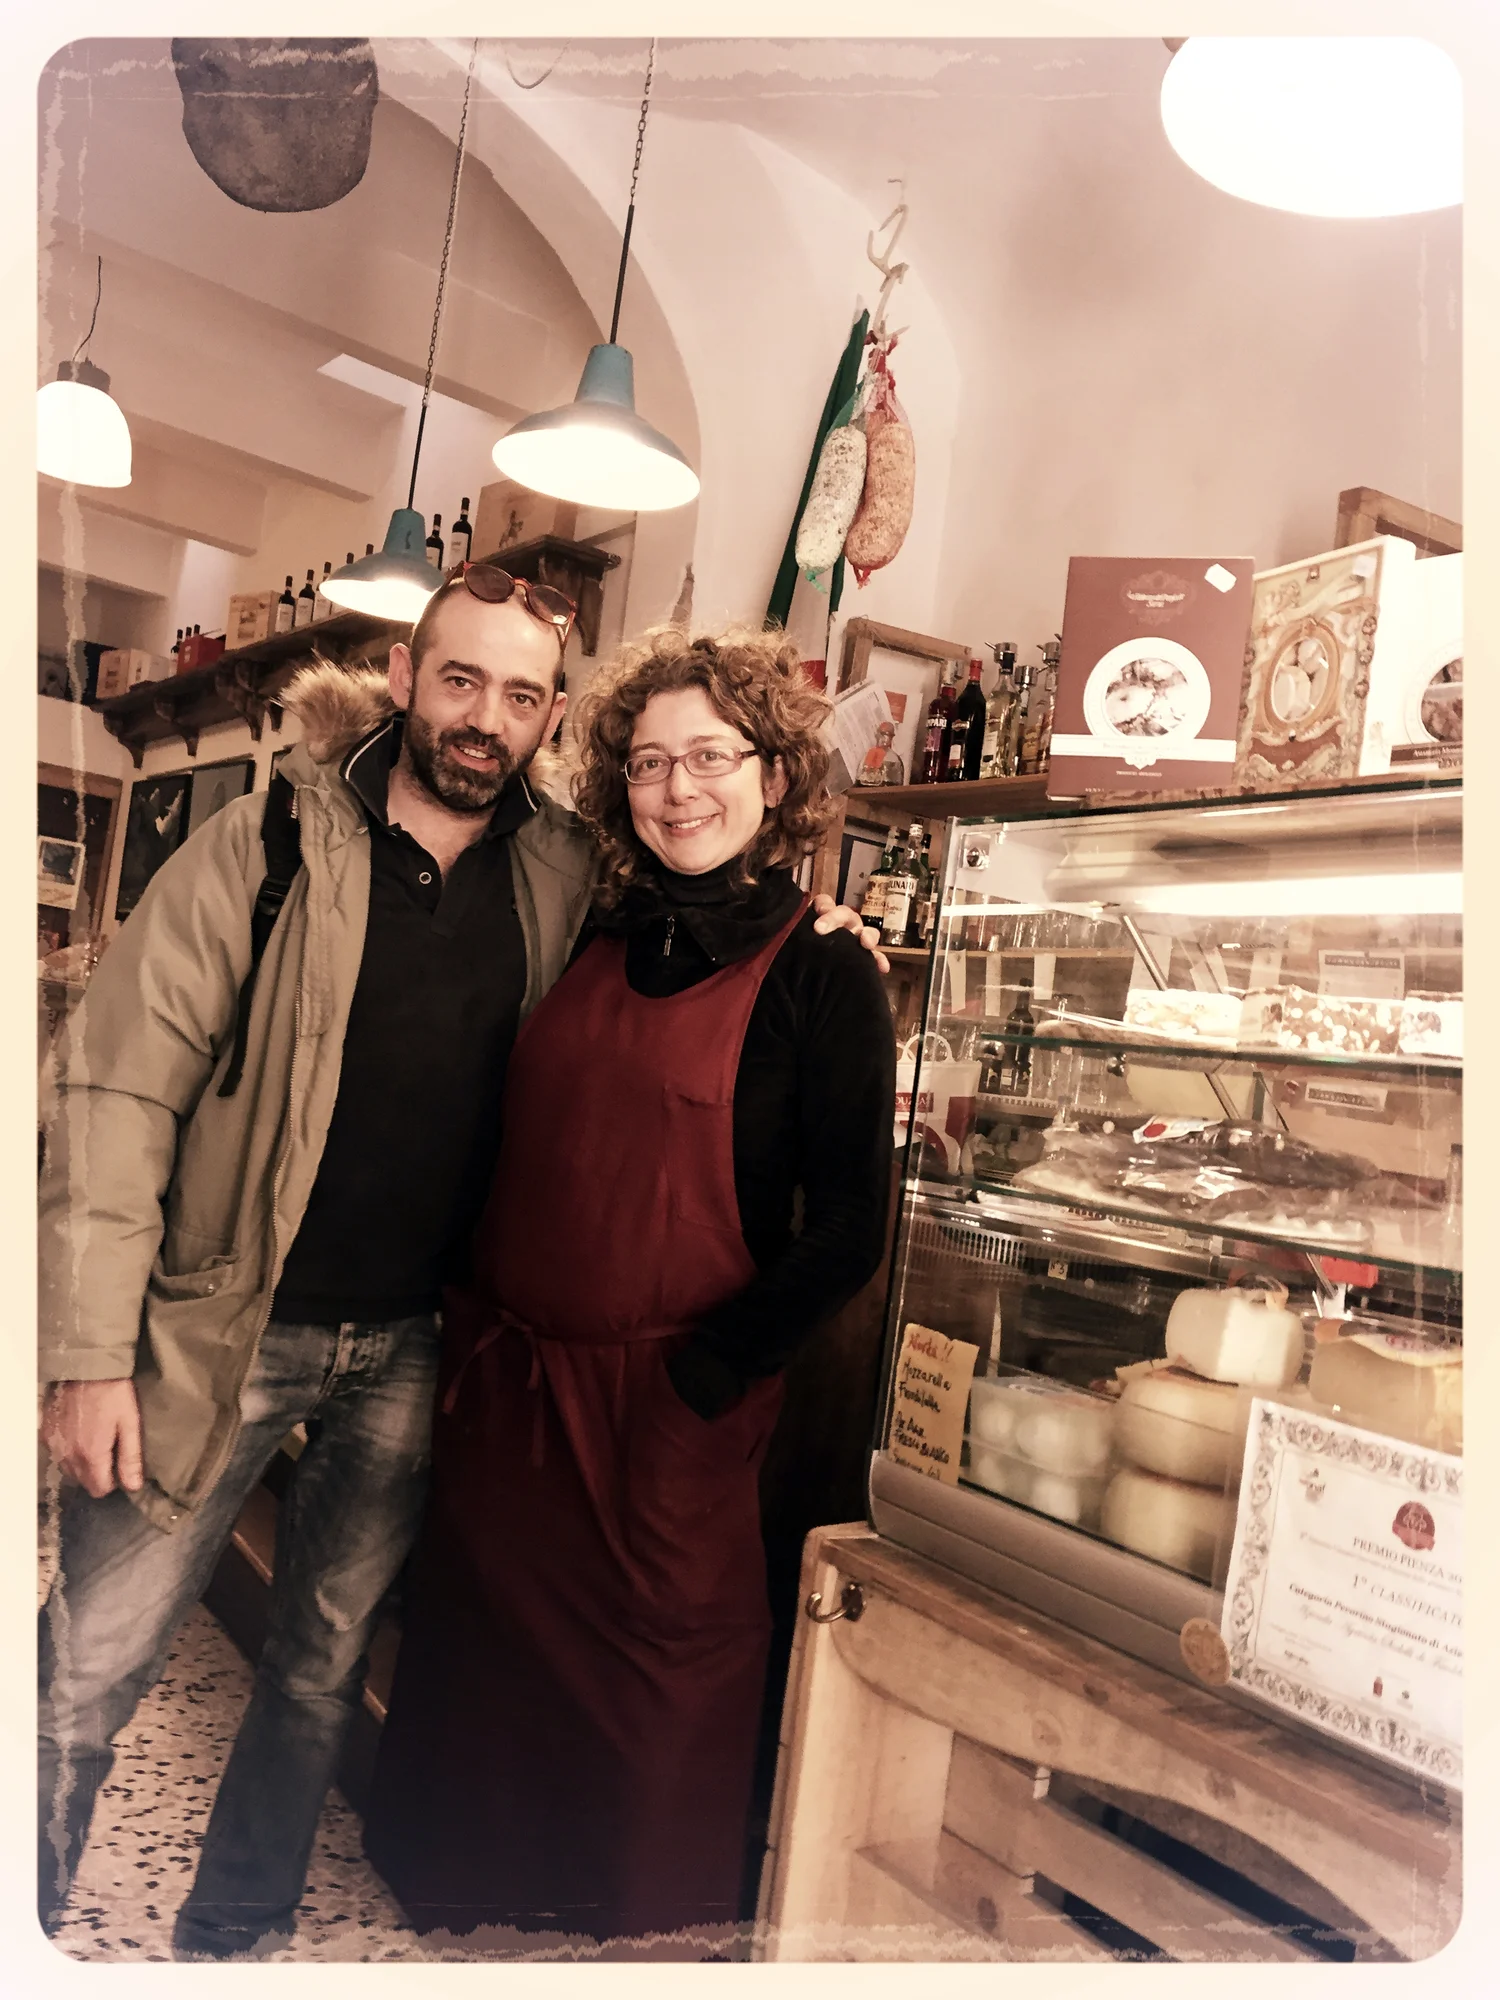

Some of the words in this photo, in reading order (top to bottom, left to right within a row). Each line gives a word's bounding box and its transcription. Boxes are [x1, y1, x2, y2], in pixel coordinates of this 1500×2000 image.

[1353, 1536, 1398, 1561] PREMIO
[1400, 1553, 1444, 1578] PIENZA
[1289, 1583, 1332, 1607] Categoria
[1334, 1600, 1374, 1623] Pecorino
[1375, 1617, 1427, 1644] Stagionato
